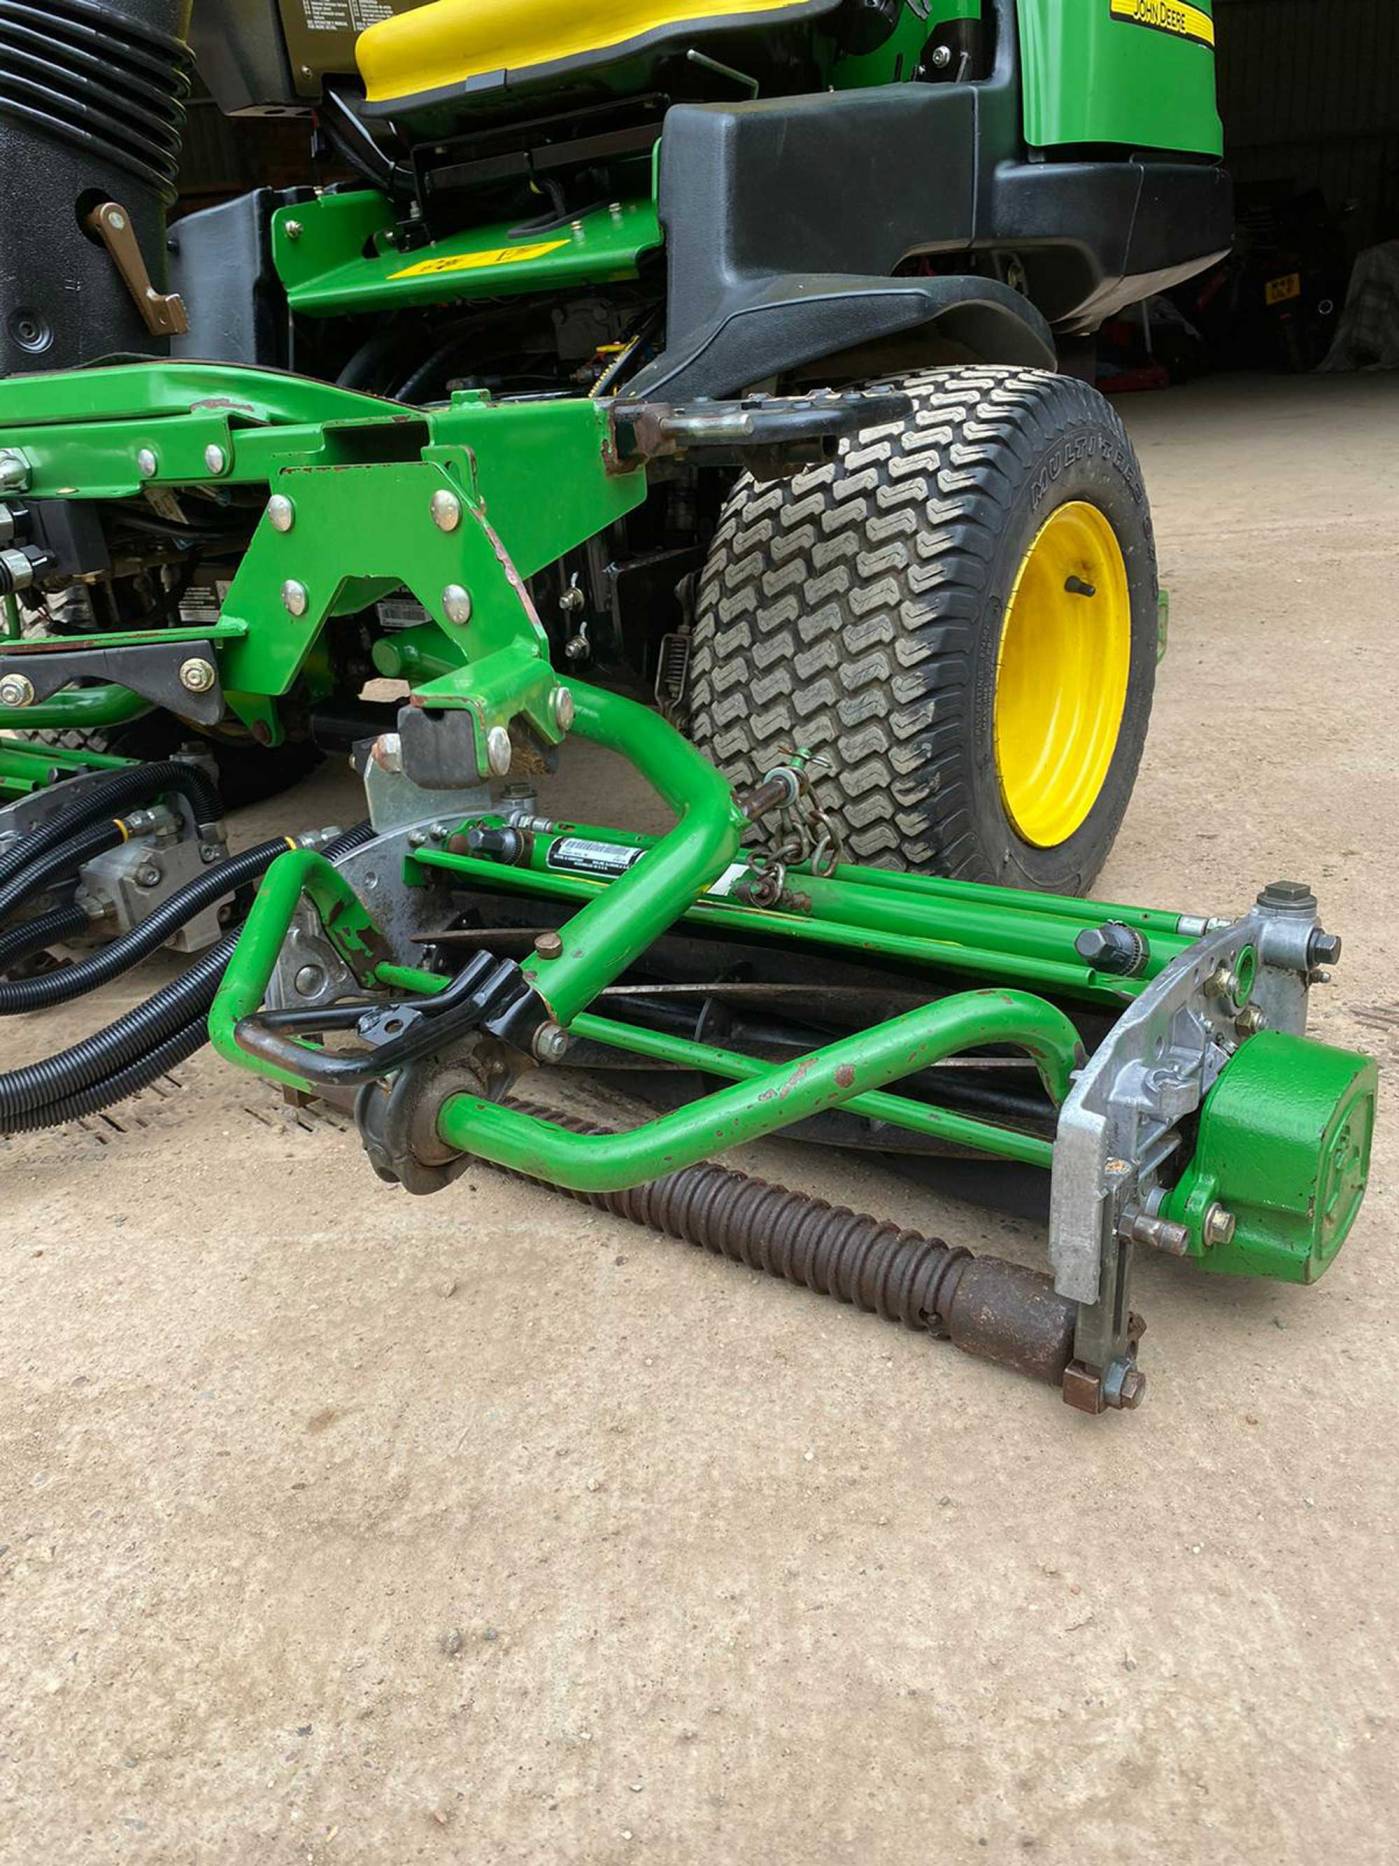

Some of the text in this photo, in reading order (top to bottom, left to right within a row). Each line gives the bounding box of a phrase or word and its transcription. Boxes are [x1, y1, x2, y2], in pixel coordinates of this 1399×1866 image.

[1134, 0, 1187, 32] JOHN DEERE
[1031, 436, 1096, 511] MULTI
